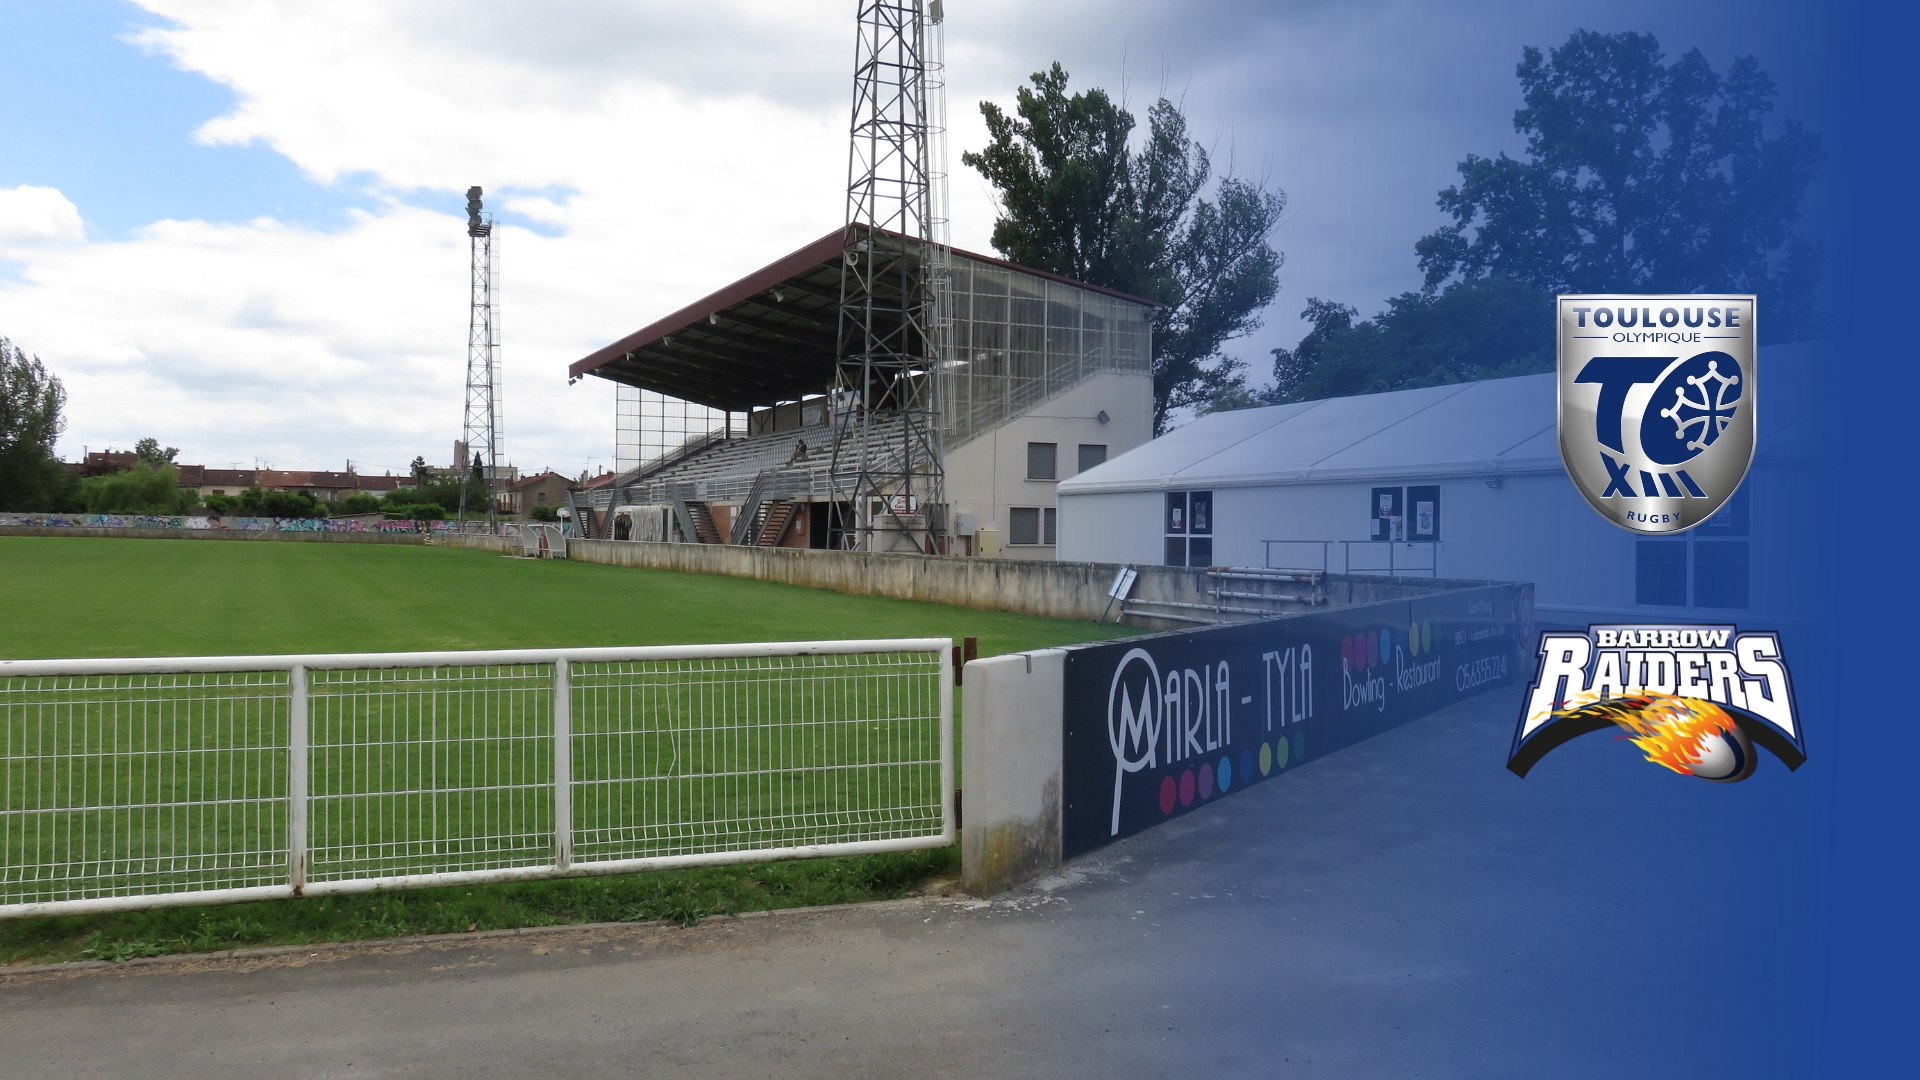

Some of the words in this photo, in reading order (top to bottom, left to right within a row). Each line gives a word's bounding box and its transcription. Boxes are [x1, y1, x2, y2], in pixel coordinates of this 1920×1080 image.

[1108, 648, 1231, 836] MARLA
[1262, 643, 1313, 731] TYLA
[1343, 657, 1385, 712] Bowling
[1396, 644, 1441, 692] Restaurant
